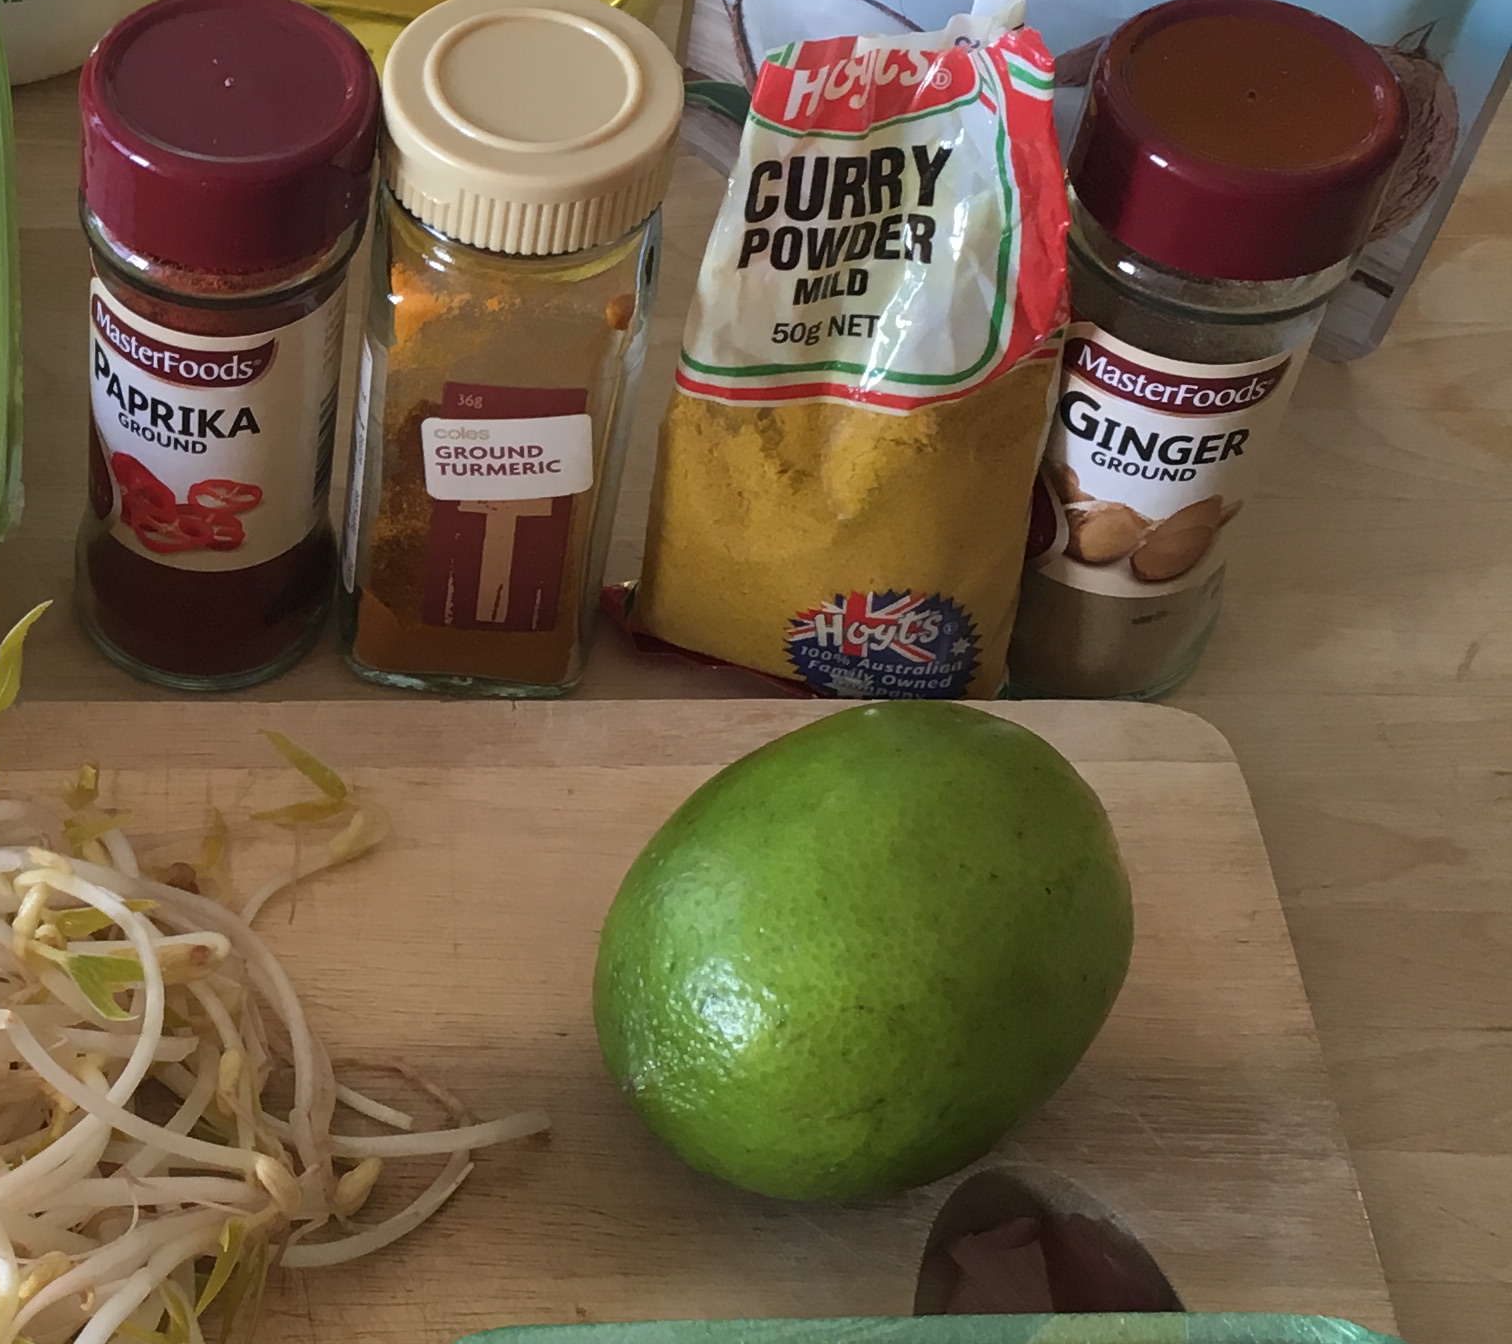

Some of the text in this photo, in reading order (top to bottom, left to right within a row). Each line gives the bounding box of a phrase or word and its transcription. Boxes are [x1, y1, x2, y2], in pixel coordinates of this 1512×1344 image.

[744, 144, 953, 223] CURRY
[737, 214, 936, 271] POWDER
[792, 269, 867, 306] MILD
[96, 302, 254, 381] MasterFoods
[771, 314, 879, 345] 50g NET
[94, 338, 261, 439] PAPRIKA
[1077, 344, 1268, 407] MasterFoods
[458, 394, 483, 409] 36g
[118, 411, 207, 455] GROUND
[434, 427, 490, 440] coles
[1060, 391, 1250, 465] GINGER
[436, 445, 543, 459] GROUND
[436, 460, 561, 476] TURMERIC
[1091, 452, 1196, 481] GROUND
[801, 646, 962, 675] 100% Australian
[808, 660, 952, 689] Family Owned
